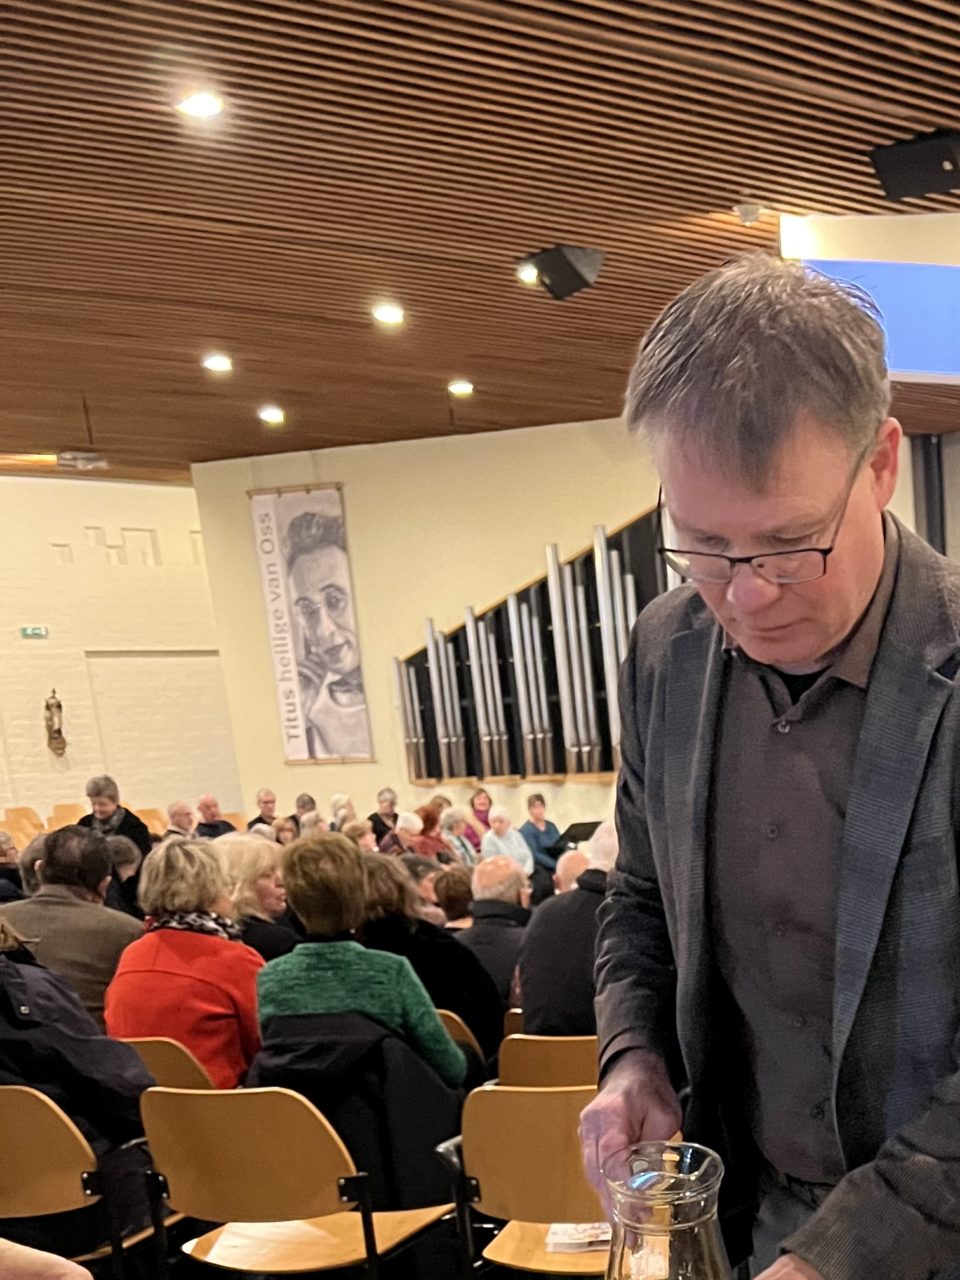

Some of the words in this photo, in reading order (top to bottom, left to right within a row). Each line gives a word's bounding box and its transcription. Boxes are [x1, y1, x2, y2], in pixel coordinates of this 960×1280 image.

[258, 512, 277, 556] Oss
[265, 562, 283, 602] van
[270, 608, 294, 683] heilige
[282, 688, 301, 744] Titus
